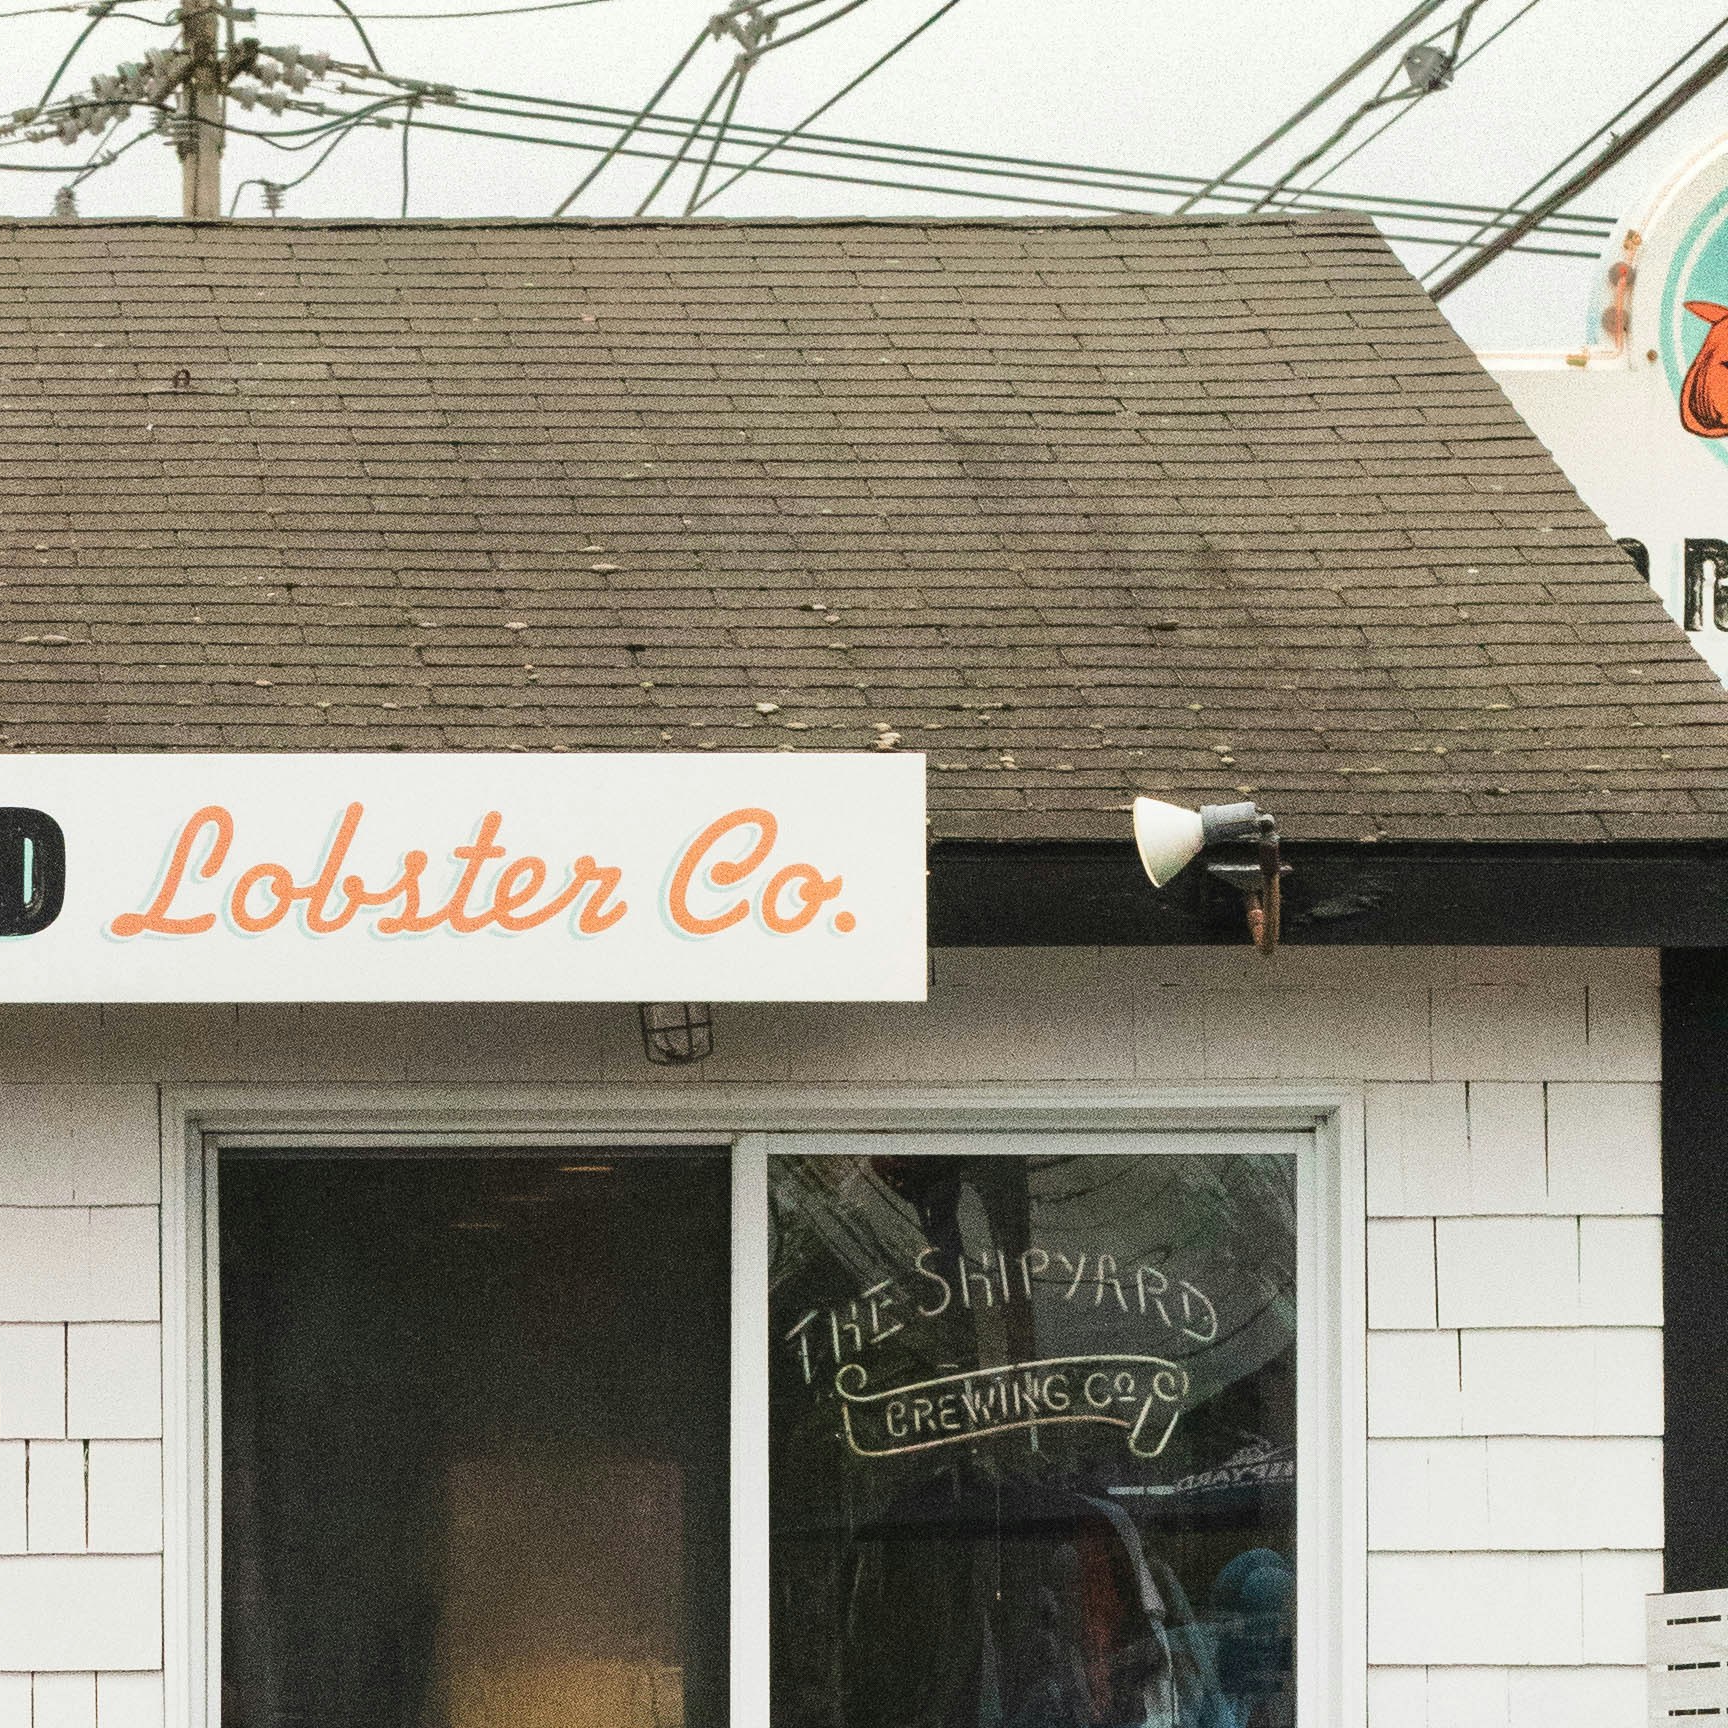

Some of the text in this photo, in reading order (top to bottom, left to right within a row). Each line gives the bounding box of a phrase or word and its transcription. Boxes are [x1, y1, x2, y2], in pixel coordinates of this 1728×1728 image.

[110, 800, 629, 938] Lobster
[666, 806, 858, 937] Co.
[785, 1246, 1218, 1385] THE SHIPYARD
[885, 1372, 1072, 1438] BREWING
